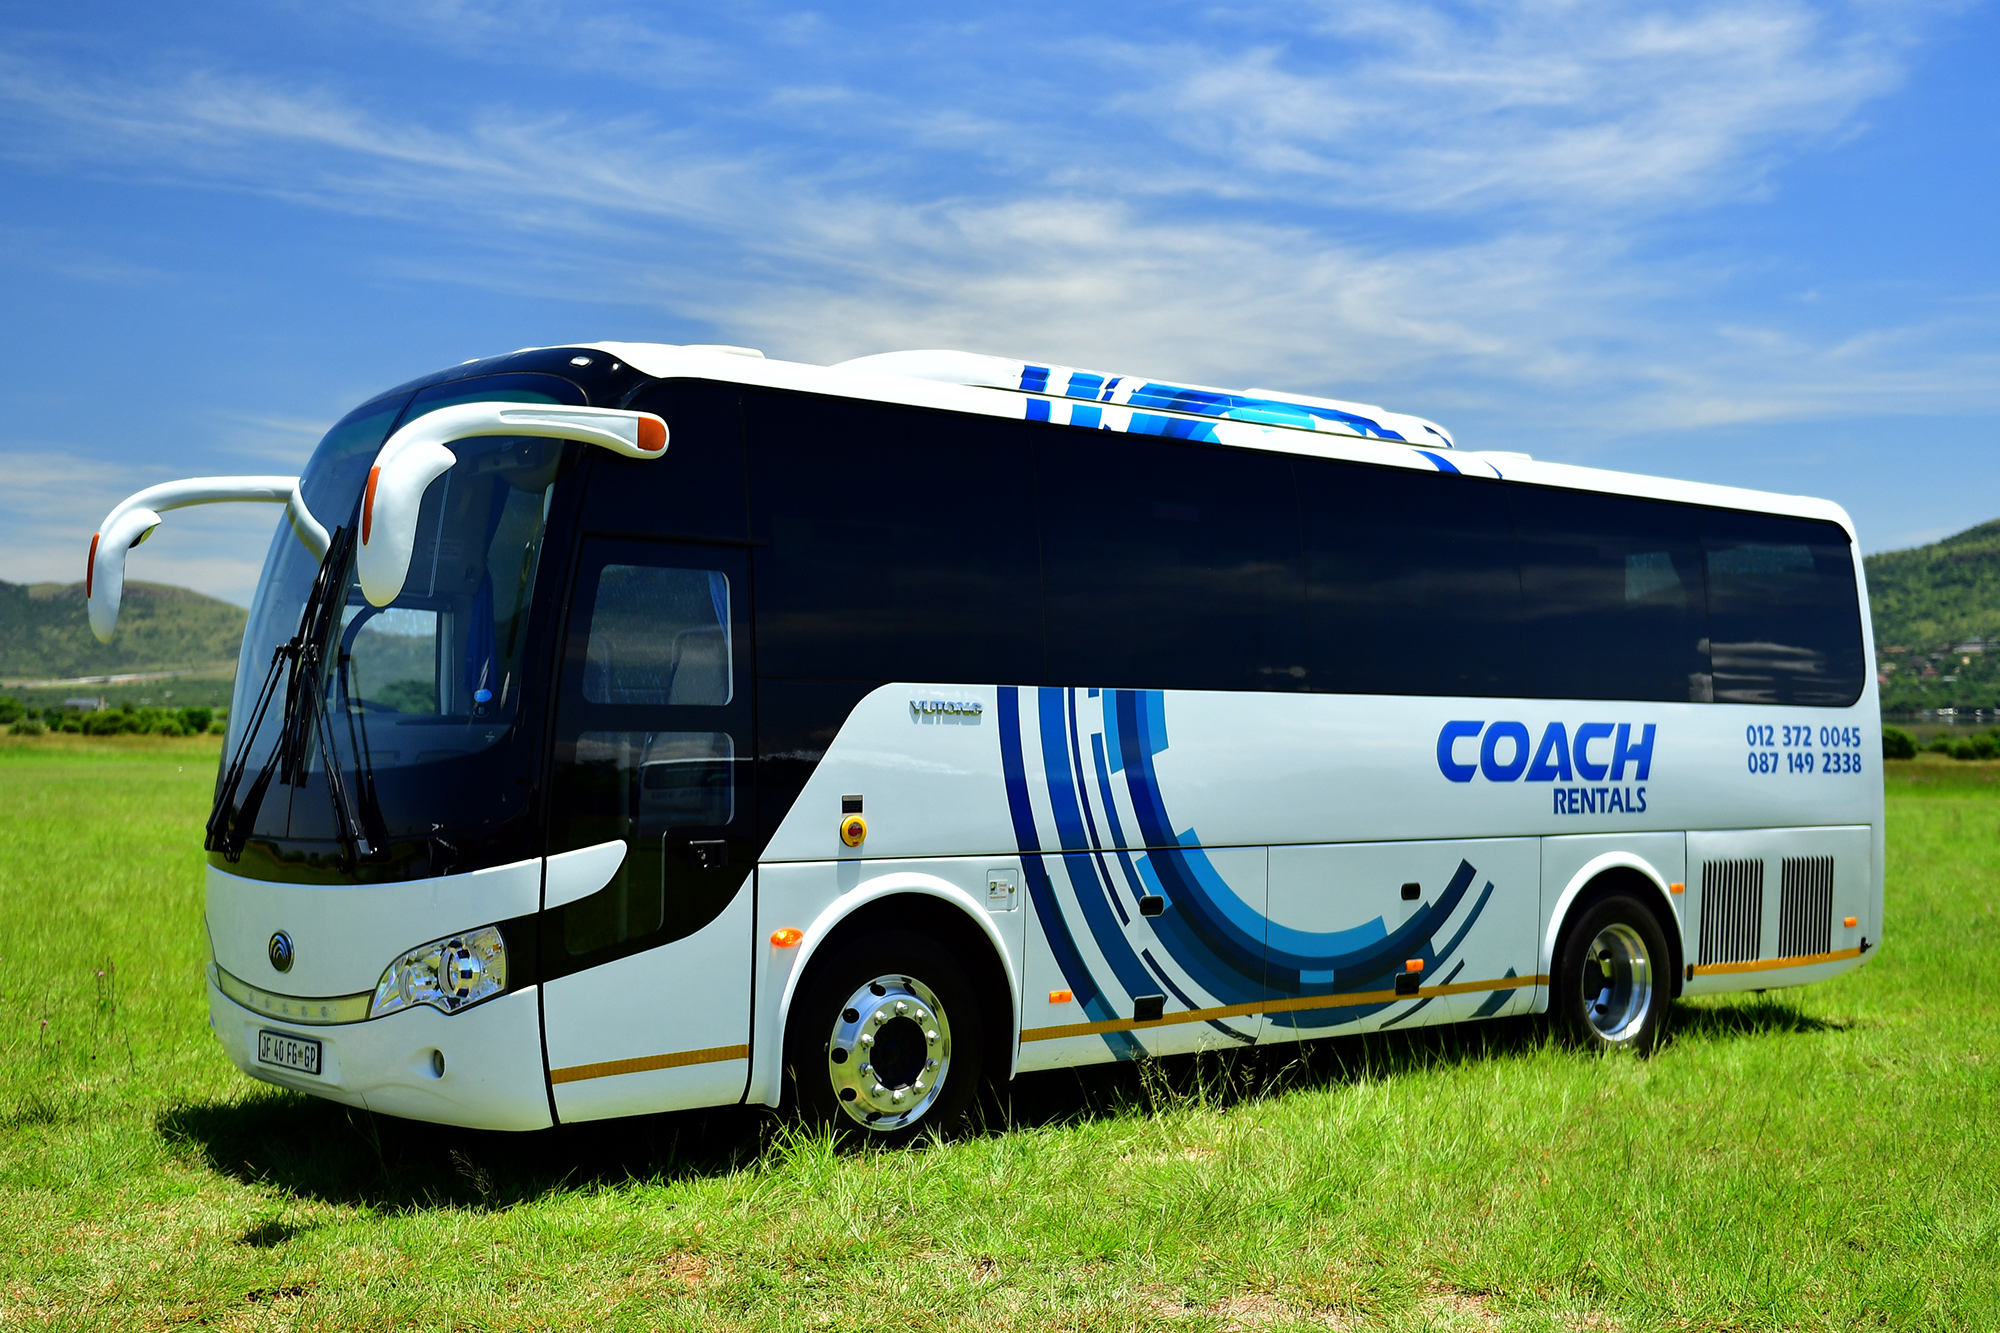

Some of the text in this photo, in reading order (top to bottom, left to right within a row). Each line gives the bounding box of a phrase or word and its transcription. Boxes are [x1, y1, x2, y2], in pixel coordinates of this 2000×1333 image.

[909, 700, 983, 716] YUTONG
[1746, 725, 1861, 748] 012 372 0045
[1436, 720, 1657, 783] COACH
[1747, 752, 1862, 774] 087 149 2338
[1553, 787, 1647, 814] RENTALS
[262, 1036, 271, 1058] JF
[274, 1039, 284, 1062] 40
[304, 1045, 316, 1069] GP
